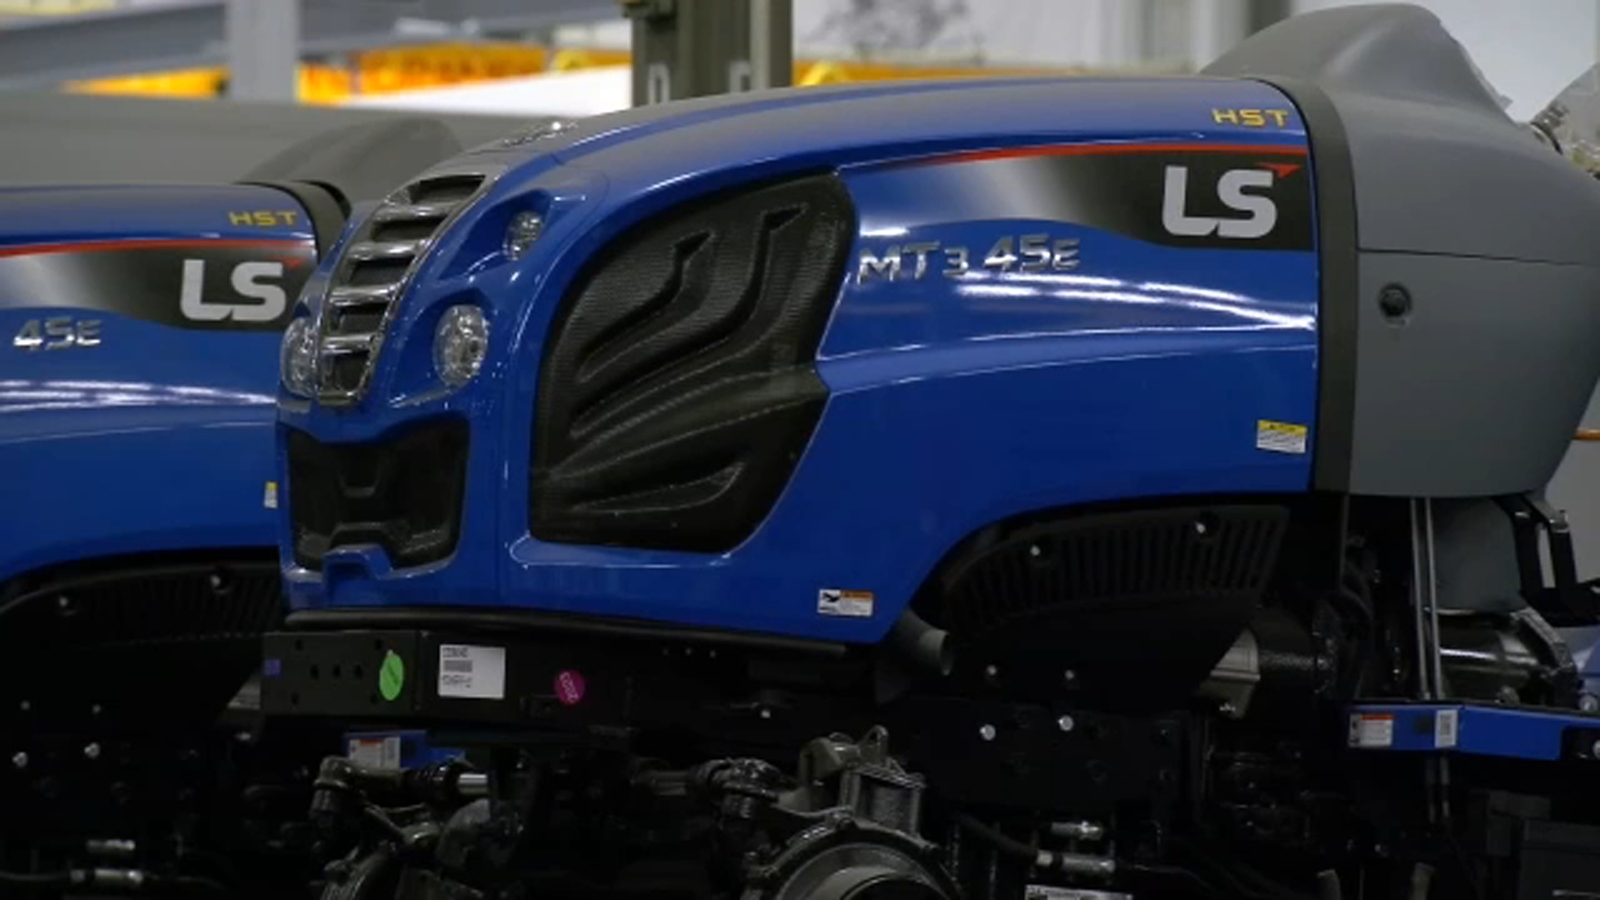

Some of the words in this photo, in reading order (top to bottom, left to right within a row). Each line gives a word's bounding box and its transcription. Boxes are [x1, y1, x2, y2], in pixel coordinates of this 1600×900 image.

[1212, 108, 1290, 127] HST
[228, 210, 297, 227] HST
[1162, 165, 1277, 238] LS
[984, 234, 1081, 273] 45E
[180, 259, 287, 321] LS
[12, 316, 103, 351] 45E
